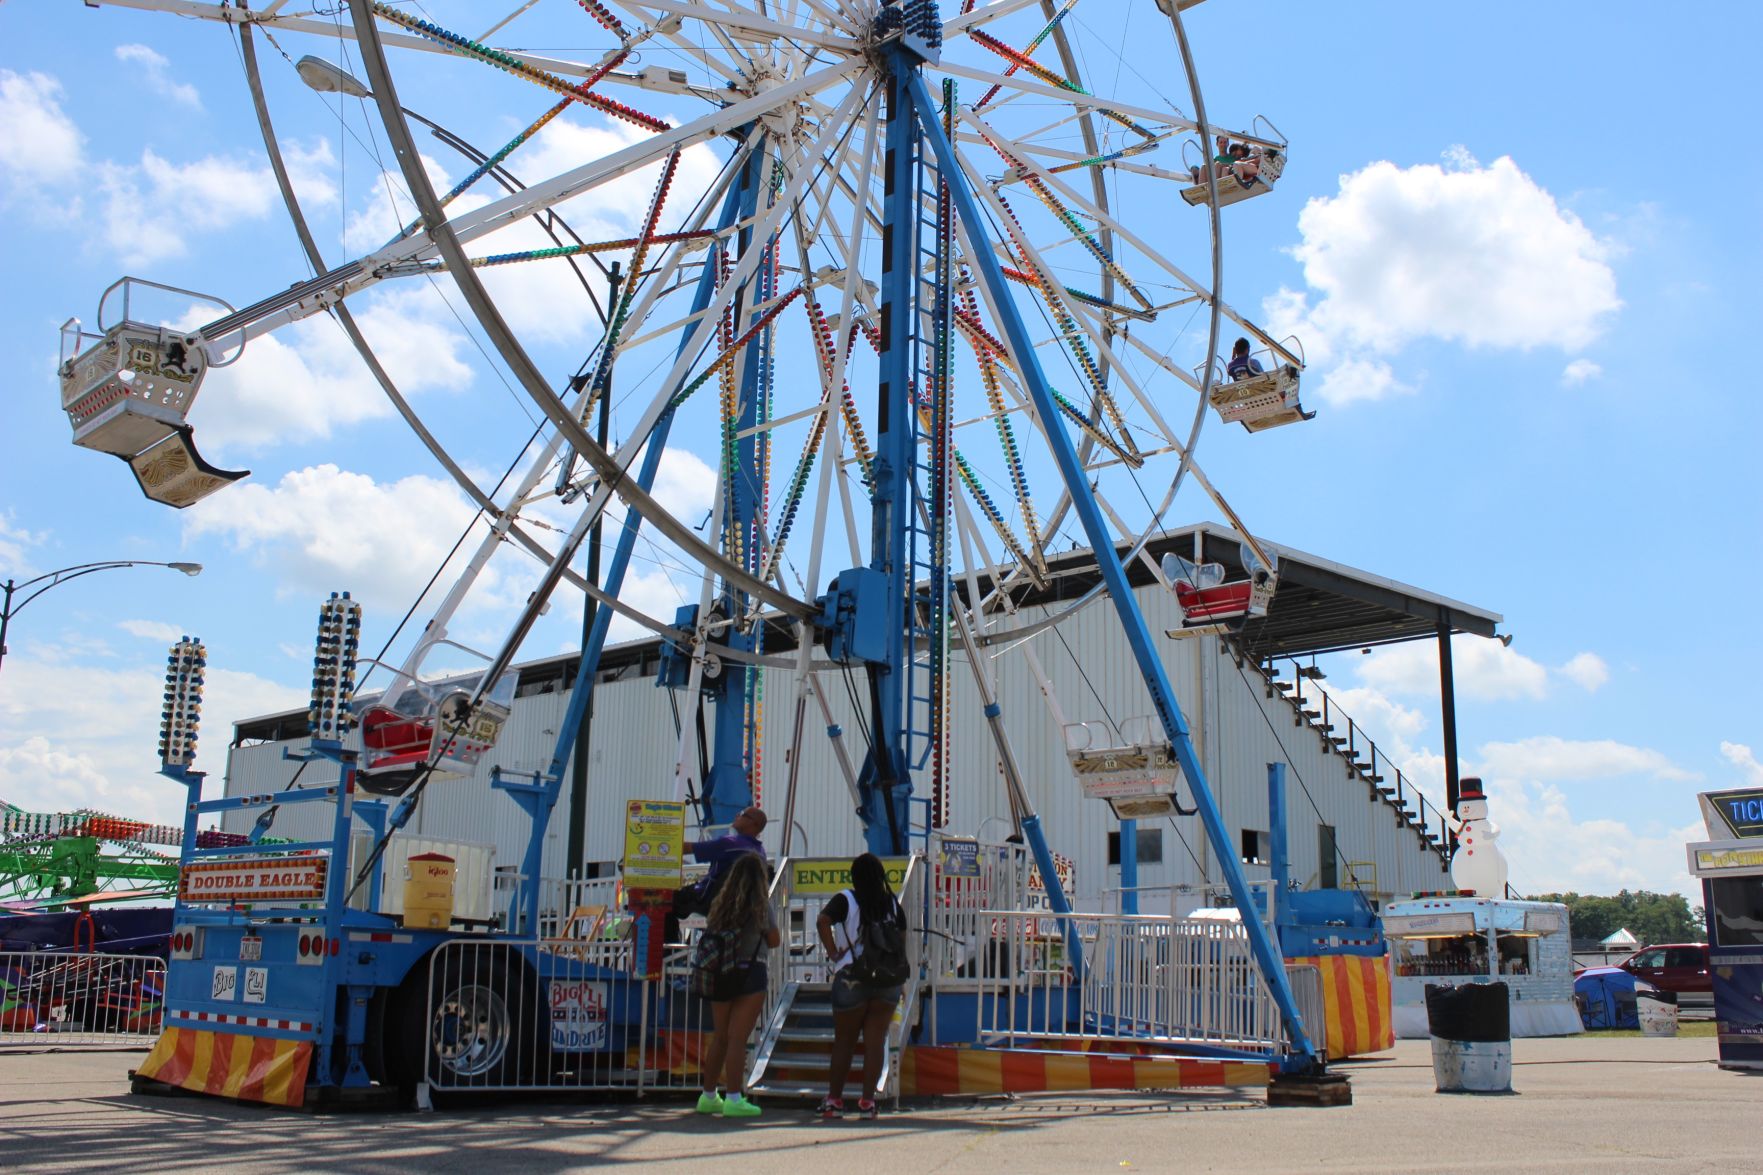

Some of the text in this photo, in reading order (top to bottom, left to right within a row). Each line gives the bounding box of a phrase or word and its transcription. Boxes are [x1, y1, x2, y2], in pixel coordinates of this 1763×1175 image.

[136, 349, 152, 362] 16
[1729, 800, 1763, 821] TIC
[944, 842, 977, 852] 3 TICKETS
[428, 866, 449, 877] igloo
[193, 872, 316, 889] DOUBLE EAGLE
